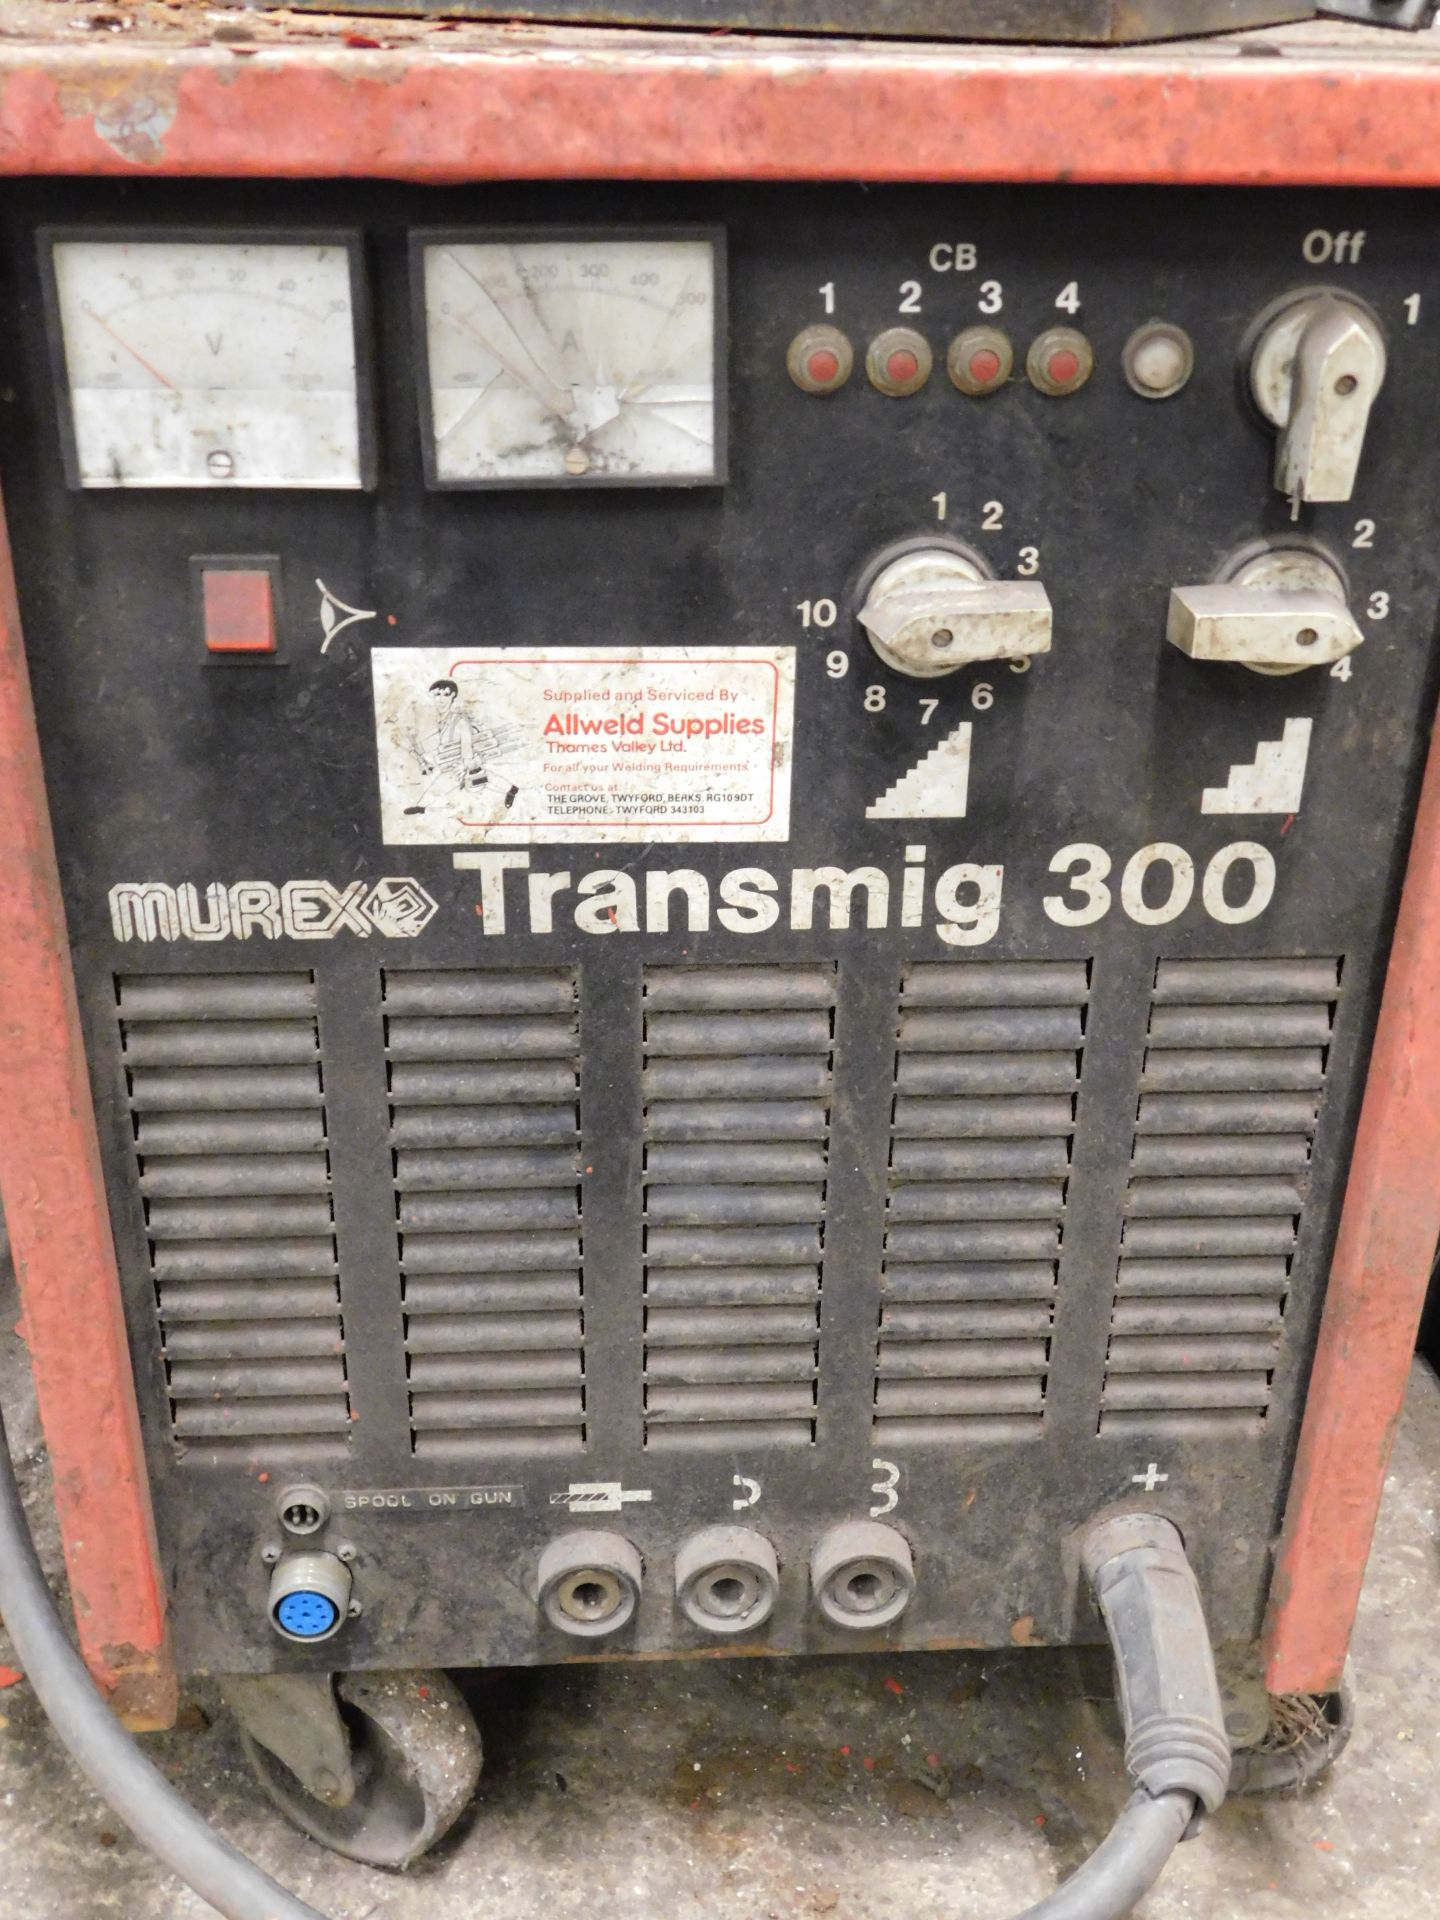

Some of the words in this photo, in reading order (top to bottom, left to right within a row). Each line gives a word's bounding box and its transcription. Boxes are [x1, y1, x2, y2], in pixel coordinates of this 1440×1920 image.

[929, 243, 977, 273] CB
[1302, 230, 1366, 264] Off
[278, 278, 297, 292] 40
[580, 264, 609, 279] 300
[630, 273, 660, 287] 400
[819, 283, 837, 314] 1
[898, 281, 922, 314] 2
[978, 281, 1003, 314] 3
[1055, 281, 1080, 314] 4
[1403, 293, 1421, 324] 1
[205, 332, 224, 356] V
[560, 330, 580, 353] A
[931, 491, 947, 520] 1
[981, 500, 1004, 530] 2
[1352, 518, 1376, 548] 2
[1017, 546, 1040, 575] 3
[796, 598, 837, 628] 10
[1366, 591, 1390, 620] 3
[826, 650, 849, 679] 9
[1329, 656, 1353, 683] 4
[543, 689, 611, 703] Supplied
[614, 689, 643, 702] and
[647, 689, 714, 702] Serviced
[719, 689, 739, 703] By
[863, 685, 887, 712] 8
[971, 682, 994, 710] 6
[919, 698, 939, 725] 7
[543, 712, 644, 736] Allweld
[652, 712, 765, 739] Supplies
[546, 741, 608, 753] Thames
[611, 741, 655, 755] Valley
[660, 740, 688, 753] Ltd.
[543, 763, 563, 773] For
[582, 764, 609, 774] your
[612, 762, 661, 775] Welding
[544, 783, 590, 792] Contact
[548, 793, 568, 803] THE
[616, 805, 667, 815] TWYFORD
[670, 805, 705, 814] 343103
[452, 850, 1004, 947] Transmig
[1043, 841, 1276, 927] 300
[109, 880, 372, 943] MUREX
[344, 1494, 412, 1509] SPOOL
[429, 1494, 456, 1506] ON
[470, 1491, 512, 1505] GUN
